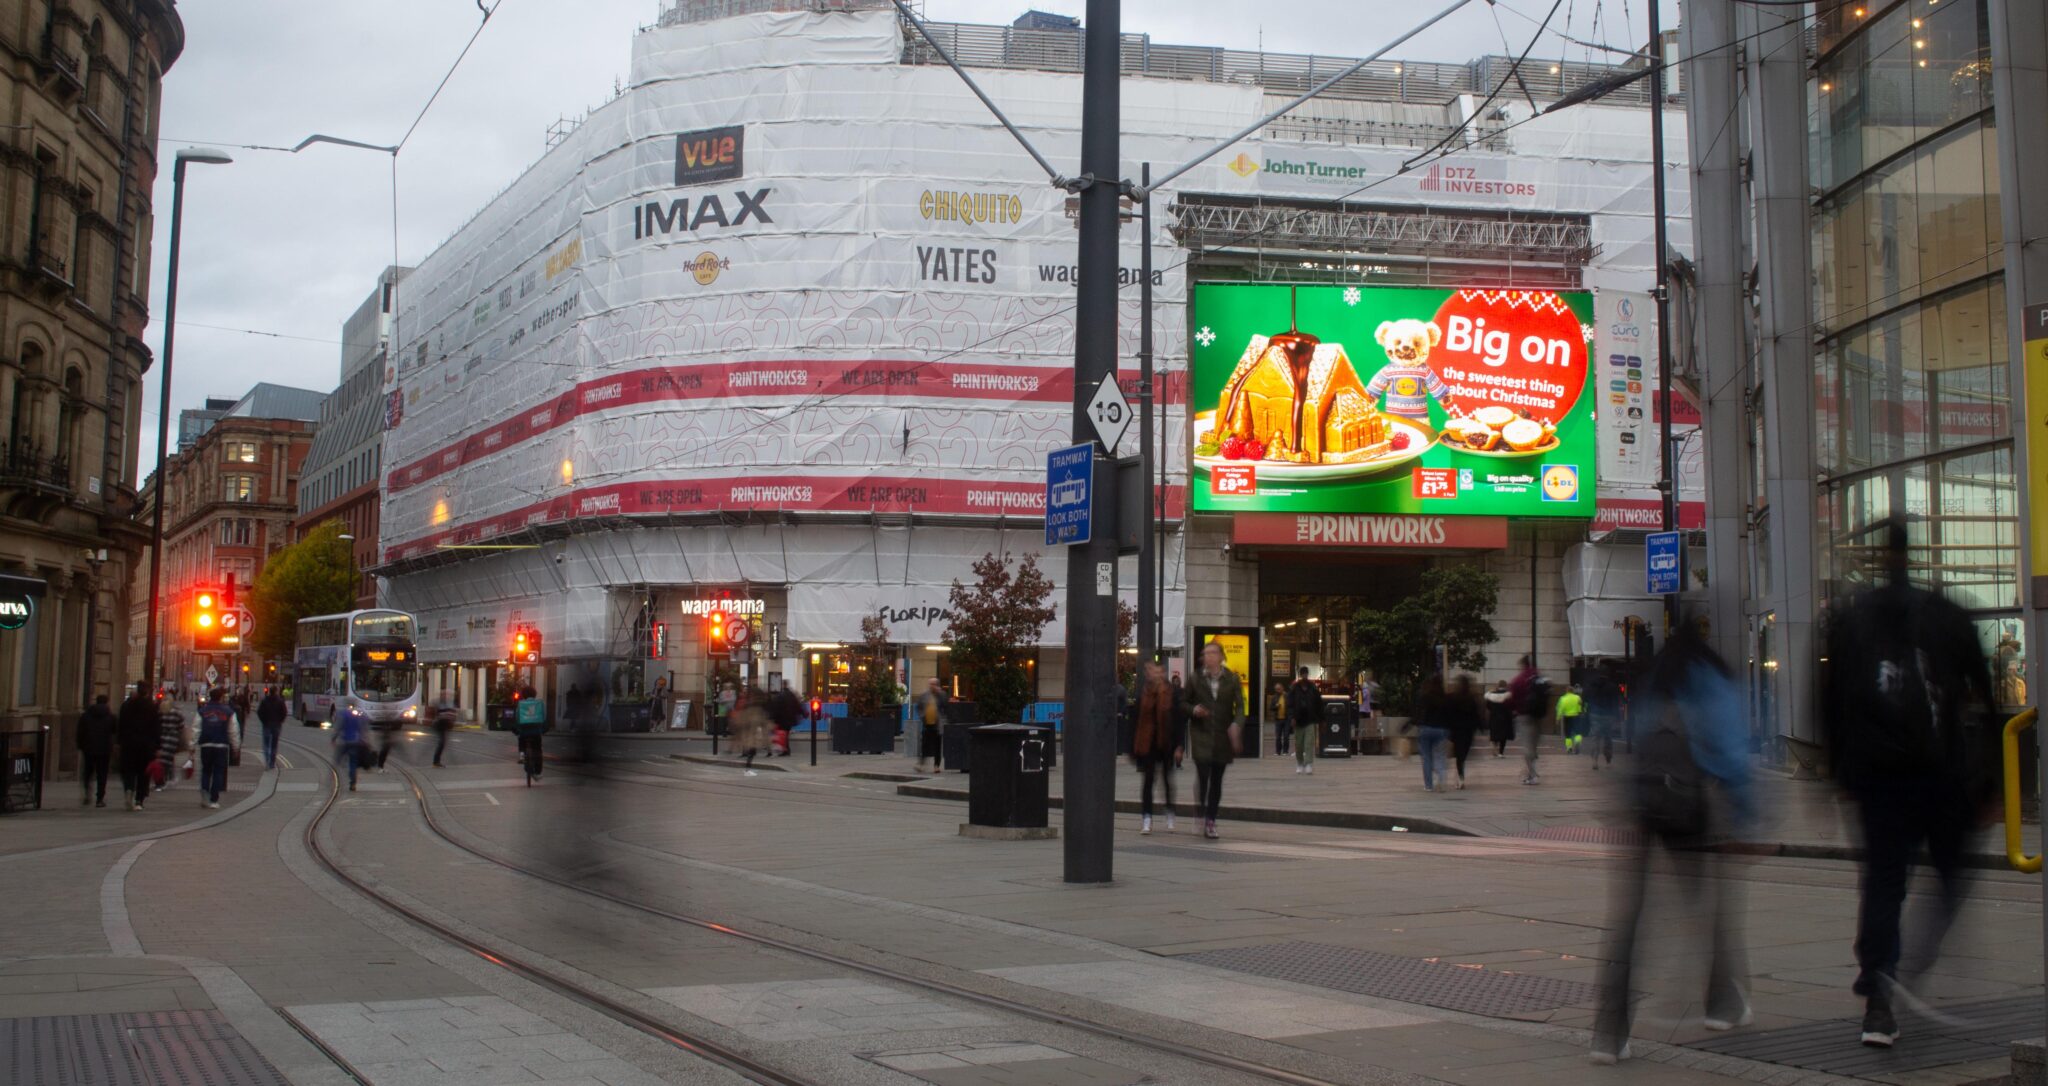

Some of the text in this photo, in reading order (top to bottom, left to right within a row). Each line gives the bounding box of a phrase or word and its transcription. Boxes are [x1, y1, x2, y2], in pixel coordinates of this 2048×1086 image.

[1446, 167, 1476, 180] DTZ
[1306, 176, 1367, 188] Construction Group
[1445, 181, 1536, 196] INVESTORS
[635, 188, 774, 240] IMAX
[919, 189, 1022, 225] CHIQUITO
[683, 256, 730, 272] Hard Rock
[917, 245, 997, 284] YATES
[1446, 315, 1571, 367] Big on
[641, 373, 702, 392] WE ARE OPEN
[729, 370, 797, 387] PRINTWORKS
[842, 370, 919, 386] WE ARE OPEN
[952, 373, 1028, 391] PRINTWORKS
[1443, 367, 1565, 397] the sweetest thing
[1449, 384, 1556, 409] about Christmas
[1096, 401, 1122, 423] 10
[1052, 451, 1087, 468] TRAMWAY
[1487, 474, 1499, 484] Big
[1510, 475, 1534, 485] quality
[731, 486, 802, 502] PRINTWORKS
[848, 487, 927, 503] WE ARE OPEN
[1422, 482, 1448, 494] £1.75
[640, 489, 702, 504] WE ARE OPEN
[967, 490, 1043, 508] PRINTWORKS
[1048, 508, 1088, 526] LOOK BOTH
[1594, 508, 1663, 524] PRINTWORKS
[1057, 524, 1078, 538] WAYS
[1297, 515, 1445, 544] THE PRINTWORKS
[1650, 537, 1675, 545] TRAMWAY
[1663, 572, 1677, 580] BOTH
